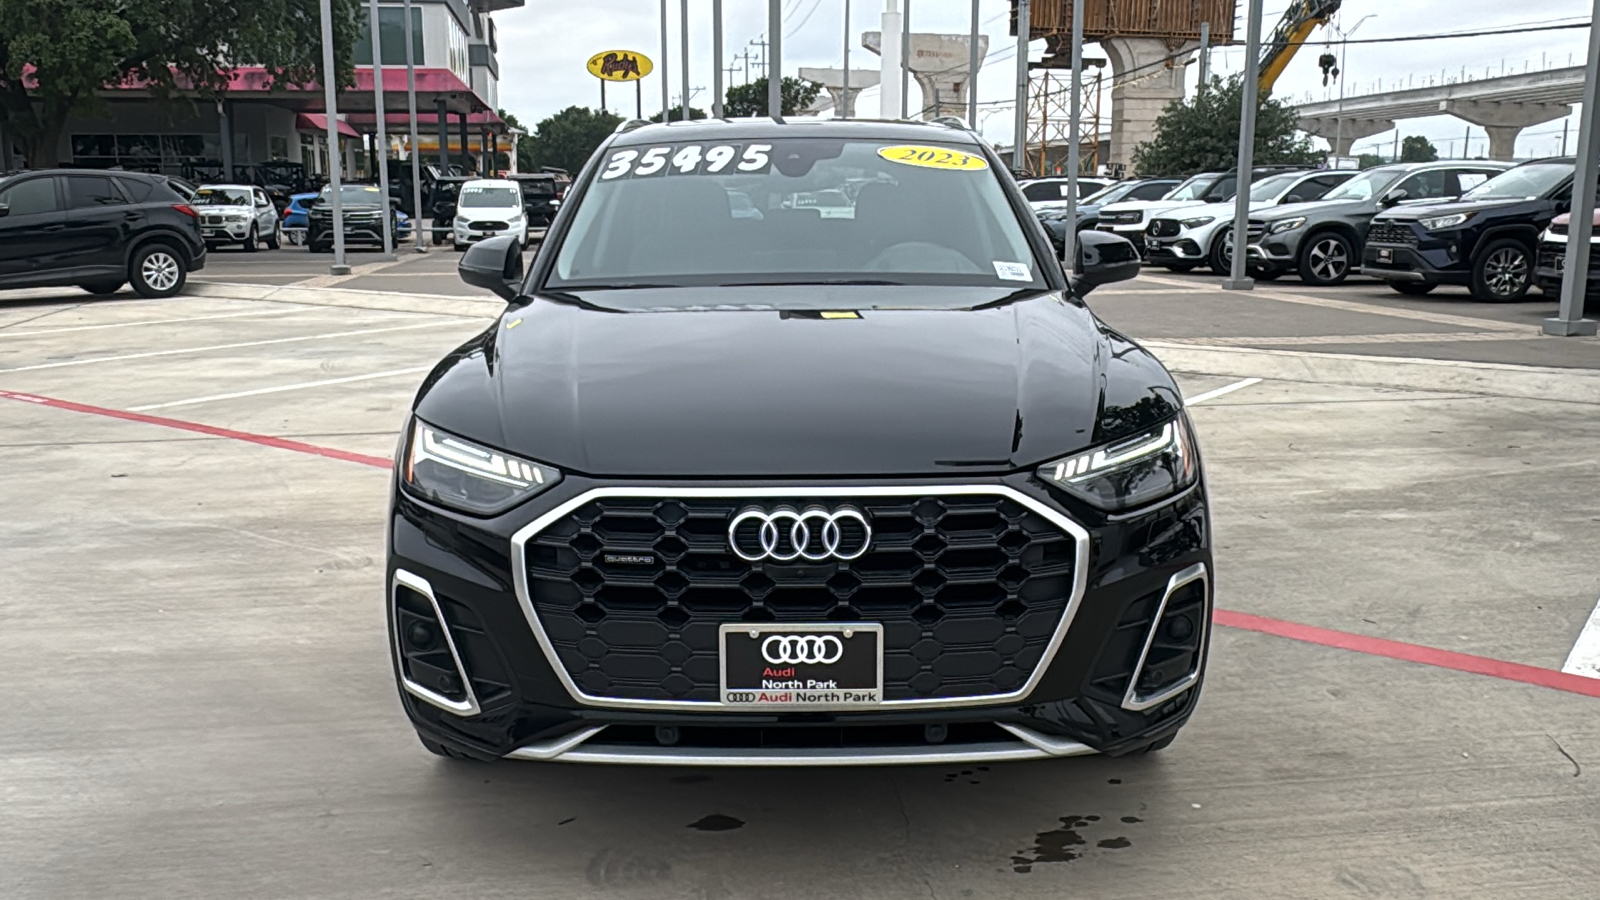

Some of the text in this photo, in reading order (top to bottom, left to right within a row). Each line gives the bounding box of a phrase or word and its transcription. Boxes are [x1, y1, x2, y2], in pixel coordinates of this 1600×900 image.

[601, 144, 772, 179] 35495
[898, 148, 971, 166] 2023
[606, 555, 652, 563] quattro
[762, 667, 795, 677] Audi
[762, 679, 838, 689] North Park
[757, 691, 877, 702] Audi North Park
